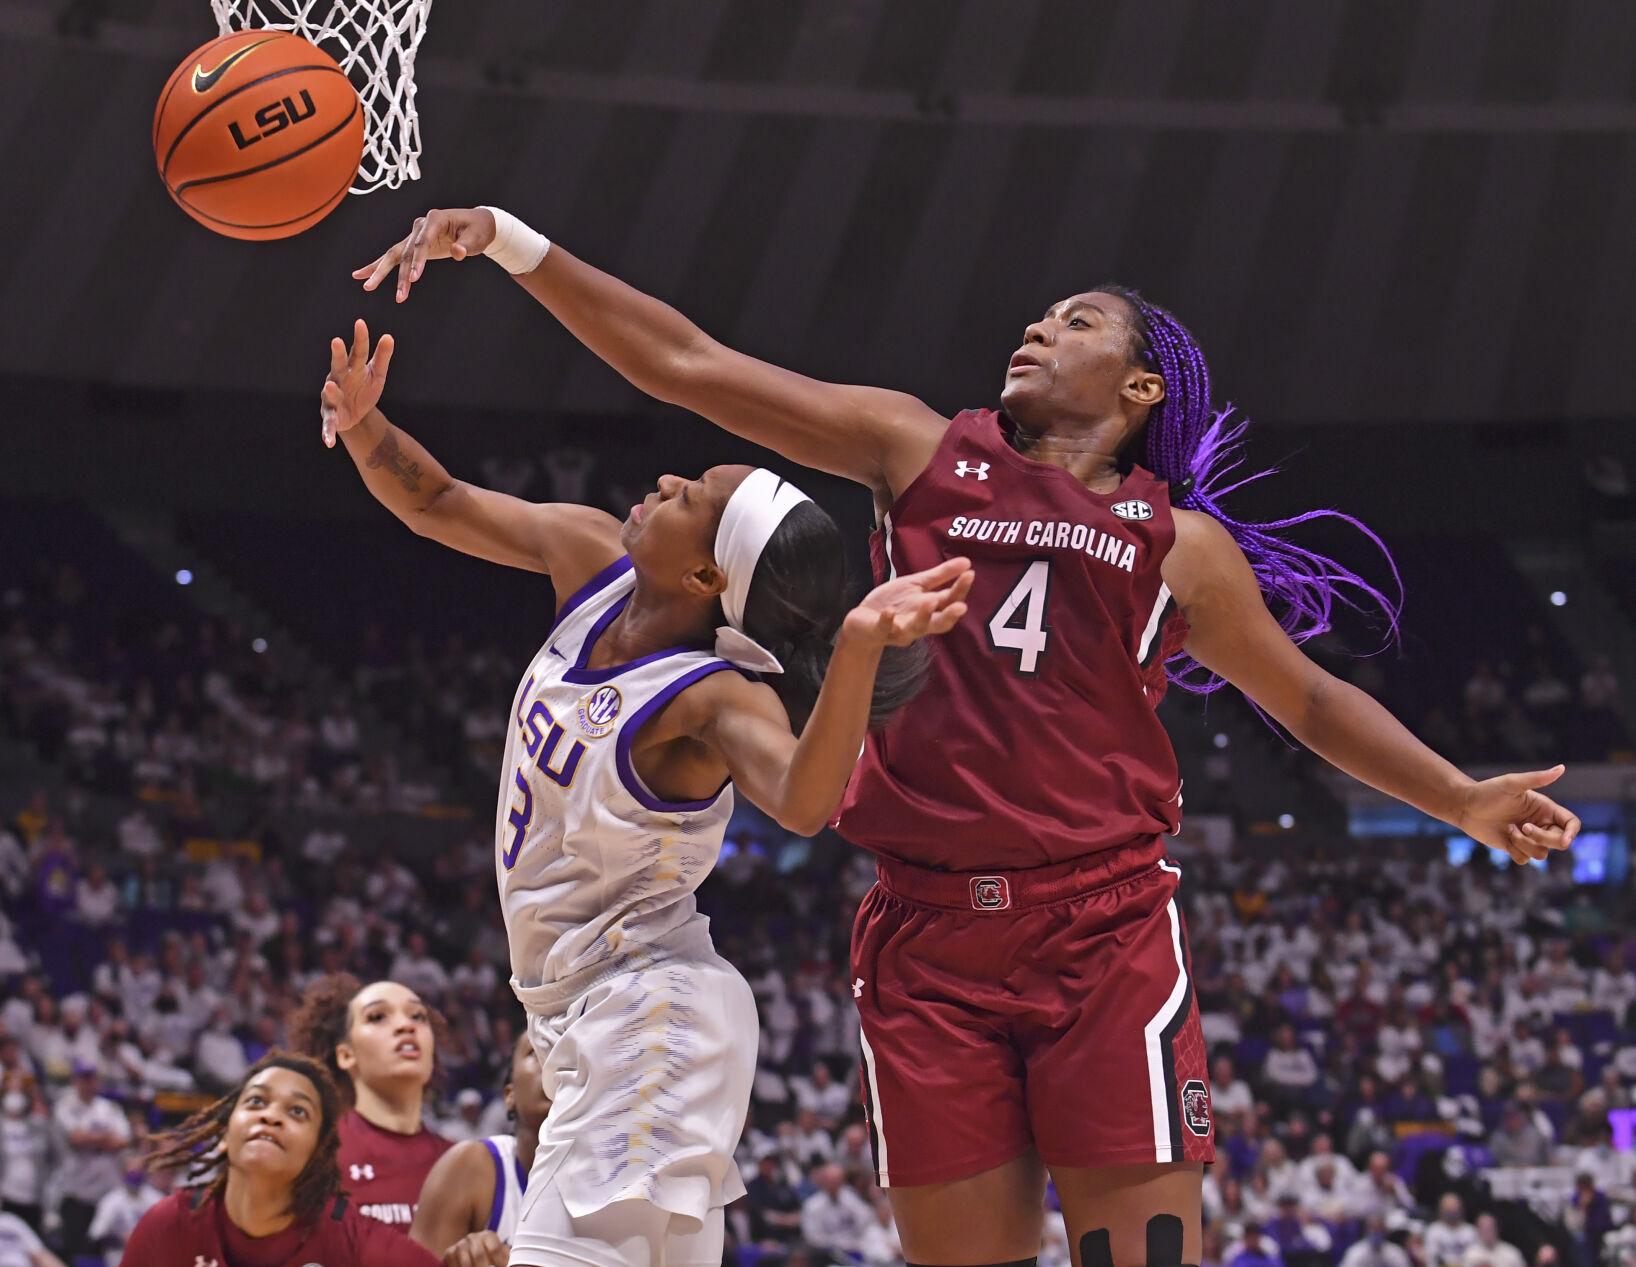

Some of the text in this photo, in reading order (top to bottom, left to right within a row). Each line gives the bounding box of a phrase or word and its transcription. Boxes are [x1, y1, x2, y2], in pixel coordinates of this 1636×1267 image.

[228, 89, 317, 151] LSU
[1113, 500, 1152, 520] SEC
[948, 516, 1137, 573] SOUTH CAROLINA
[989, 560, 1050, 673] 4
[516, 672, 589, 789] LSU
[577, 707, 606, 735] GRADUATE
[588, 687, 620, 724] SEC
[502, 766, 534, 872] 3
